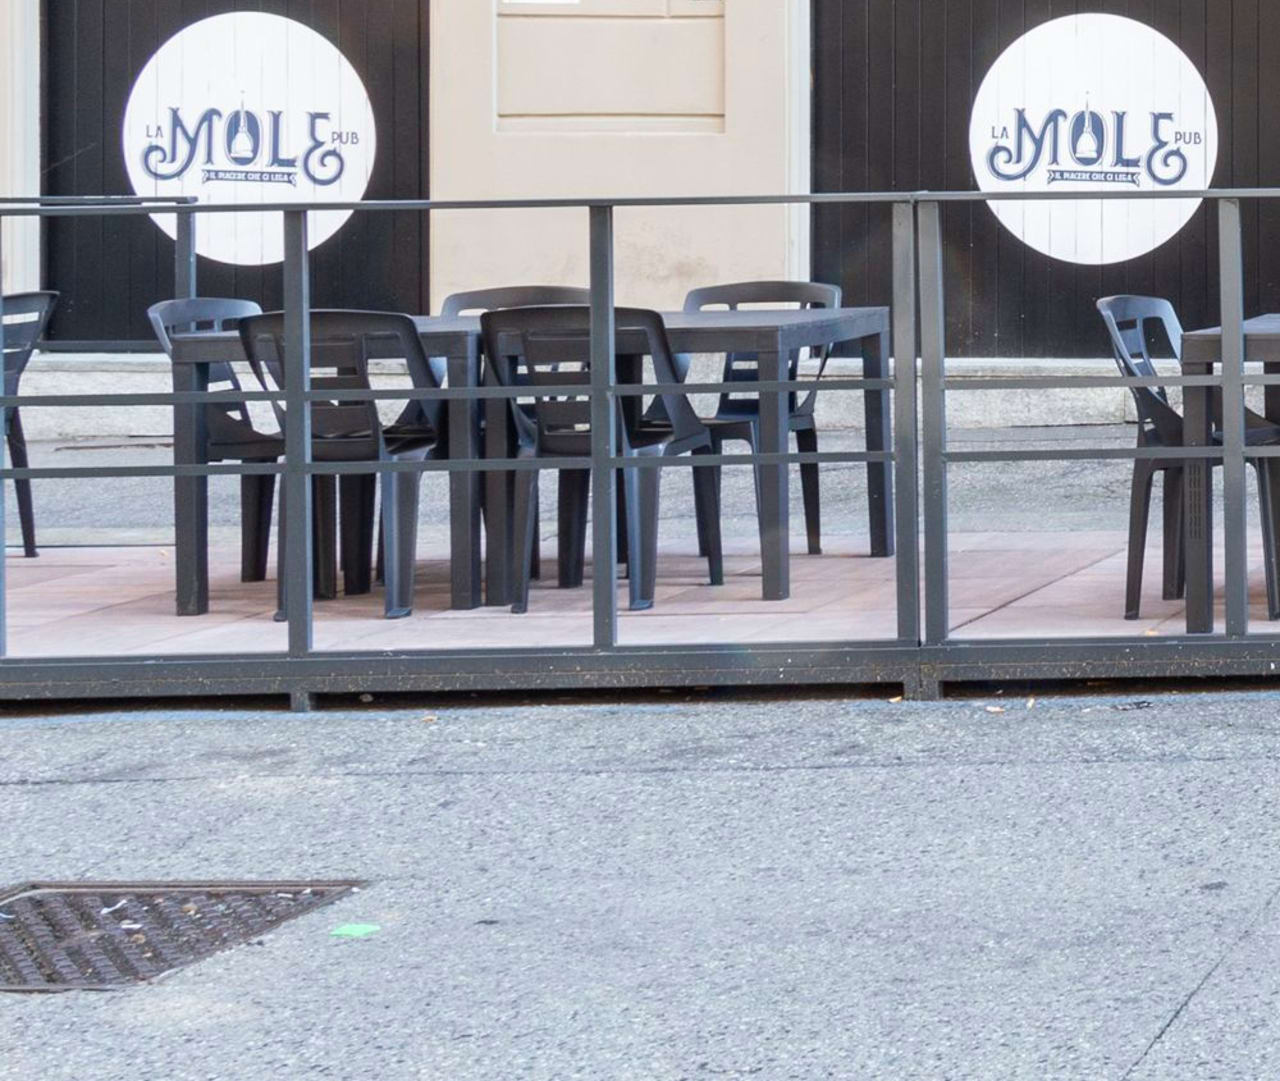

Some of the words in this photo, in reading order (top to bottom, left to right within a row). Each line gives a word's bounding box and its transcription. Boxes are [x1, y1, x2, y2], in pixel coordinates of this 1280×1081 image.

[145, 124, 164, 138] LA
[330, 131, 360, 145] PUB
[991, 125, 1009, 139] LA
[1174, 131, 1202, 145] PUB
[140, 106, 345, 186] MOLE
[986, 107, 1188, 186] MOLE
